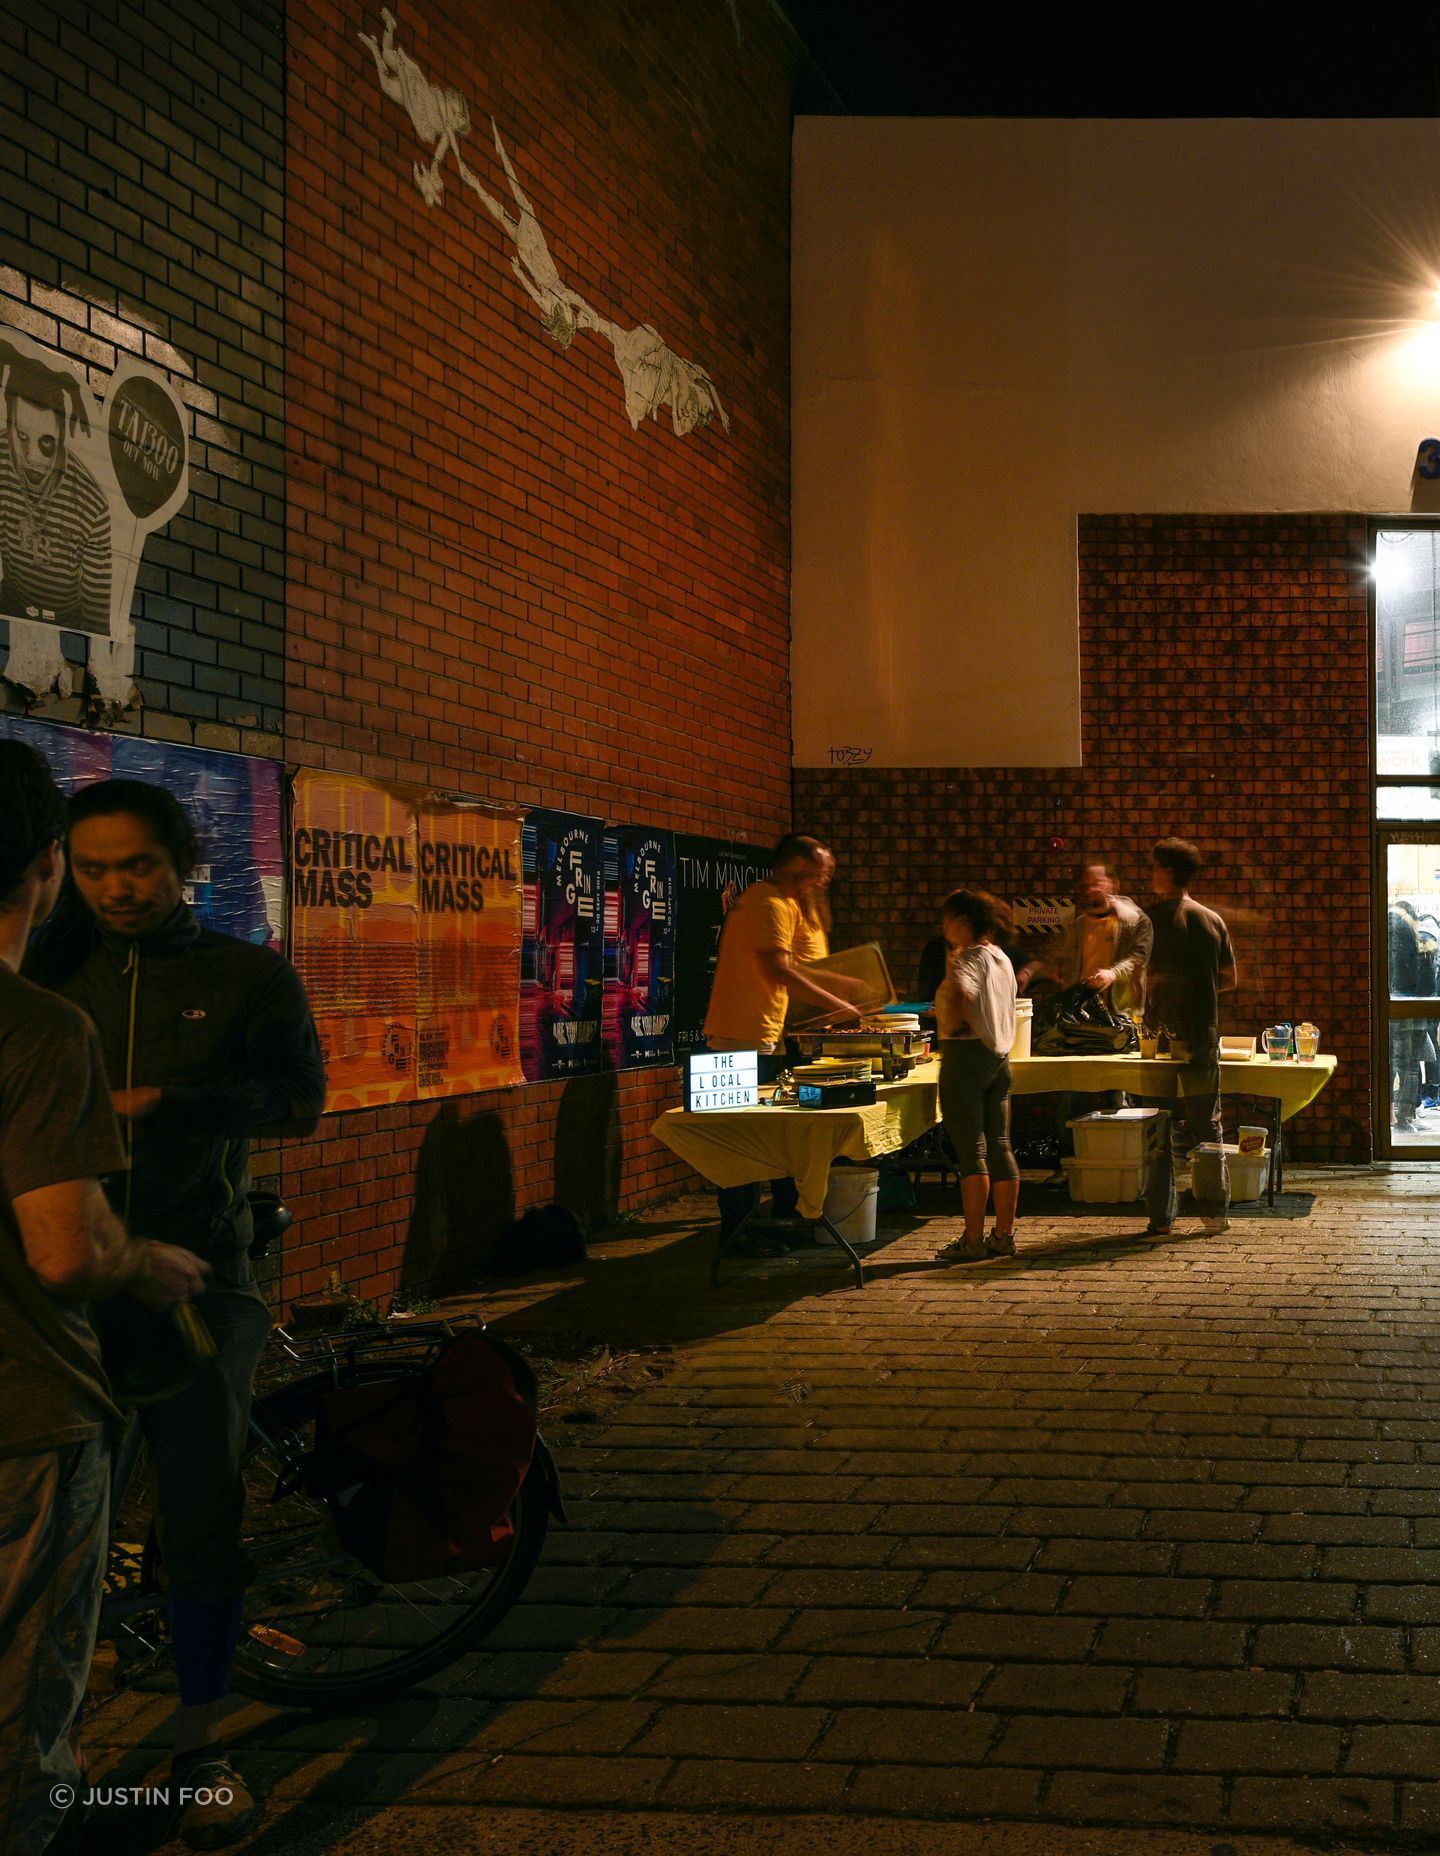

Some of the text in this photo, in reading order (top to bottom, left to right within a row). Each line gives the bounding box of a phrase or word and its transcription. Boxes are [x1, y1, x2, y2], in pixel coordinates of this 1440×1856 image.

[294, 828, 413, 874] CRITICAL
[421, 841, 517, 881] CRITICAL
[556, 828, 591, 887] MELBOURNE
[634, 839, 662, 893] MELBOURNE
[294, 868, 374, 909] MASS
[679, 856, 774, 893] TIM MINCH
[421, 878, 484, 913] MASS
[1027, 916, 1061, 924] PARKING
[713, 1054, 734, 1069] THE
[695, 1091, 750, 1108] KITCHEN
